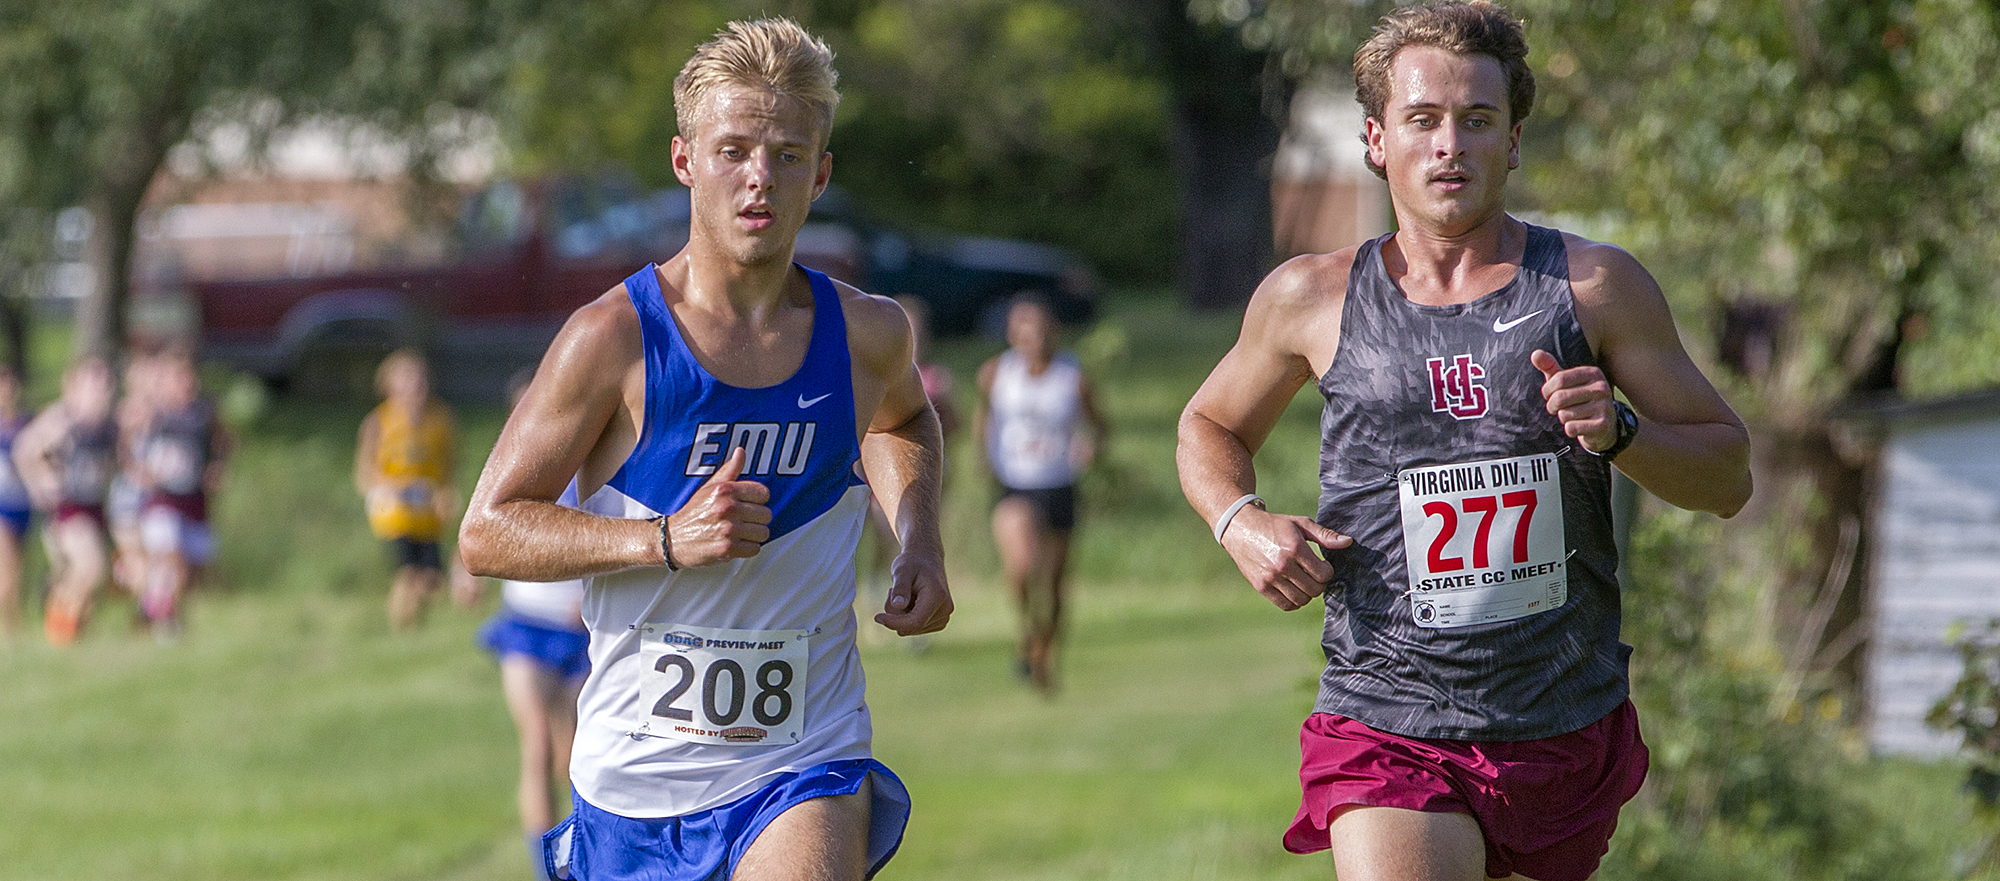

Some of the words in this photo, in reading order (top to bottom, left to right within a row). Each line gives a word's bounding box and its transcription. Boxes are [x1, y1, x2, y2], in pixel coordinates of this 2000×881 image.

[685, 421, 817, 476] EMU
[1410, 466, 1486, 496] VIRGINIA
[1491, 462, 1526, 488] DIV.
[1530, 458, 1549, 482] III
[1422, 489, 1537, 574] 277
[1421, 575, 1476, 591] STATE
[1481, 571, 1506, 584] CC
[1511, 562, 1557, 580] MEET
[663, 633, 703, 649] ODAC
[706, 639, 756, 649] PREVIEW
[757, 641, 785, 650] MEET
[651, 654, 793, 726] 208
[674, 725, 706, 735] HOSTED
